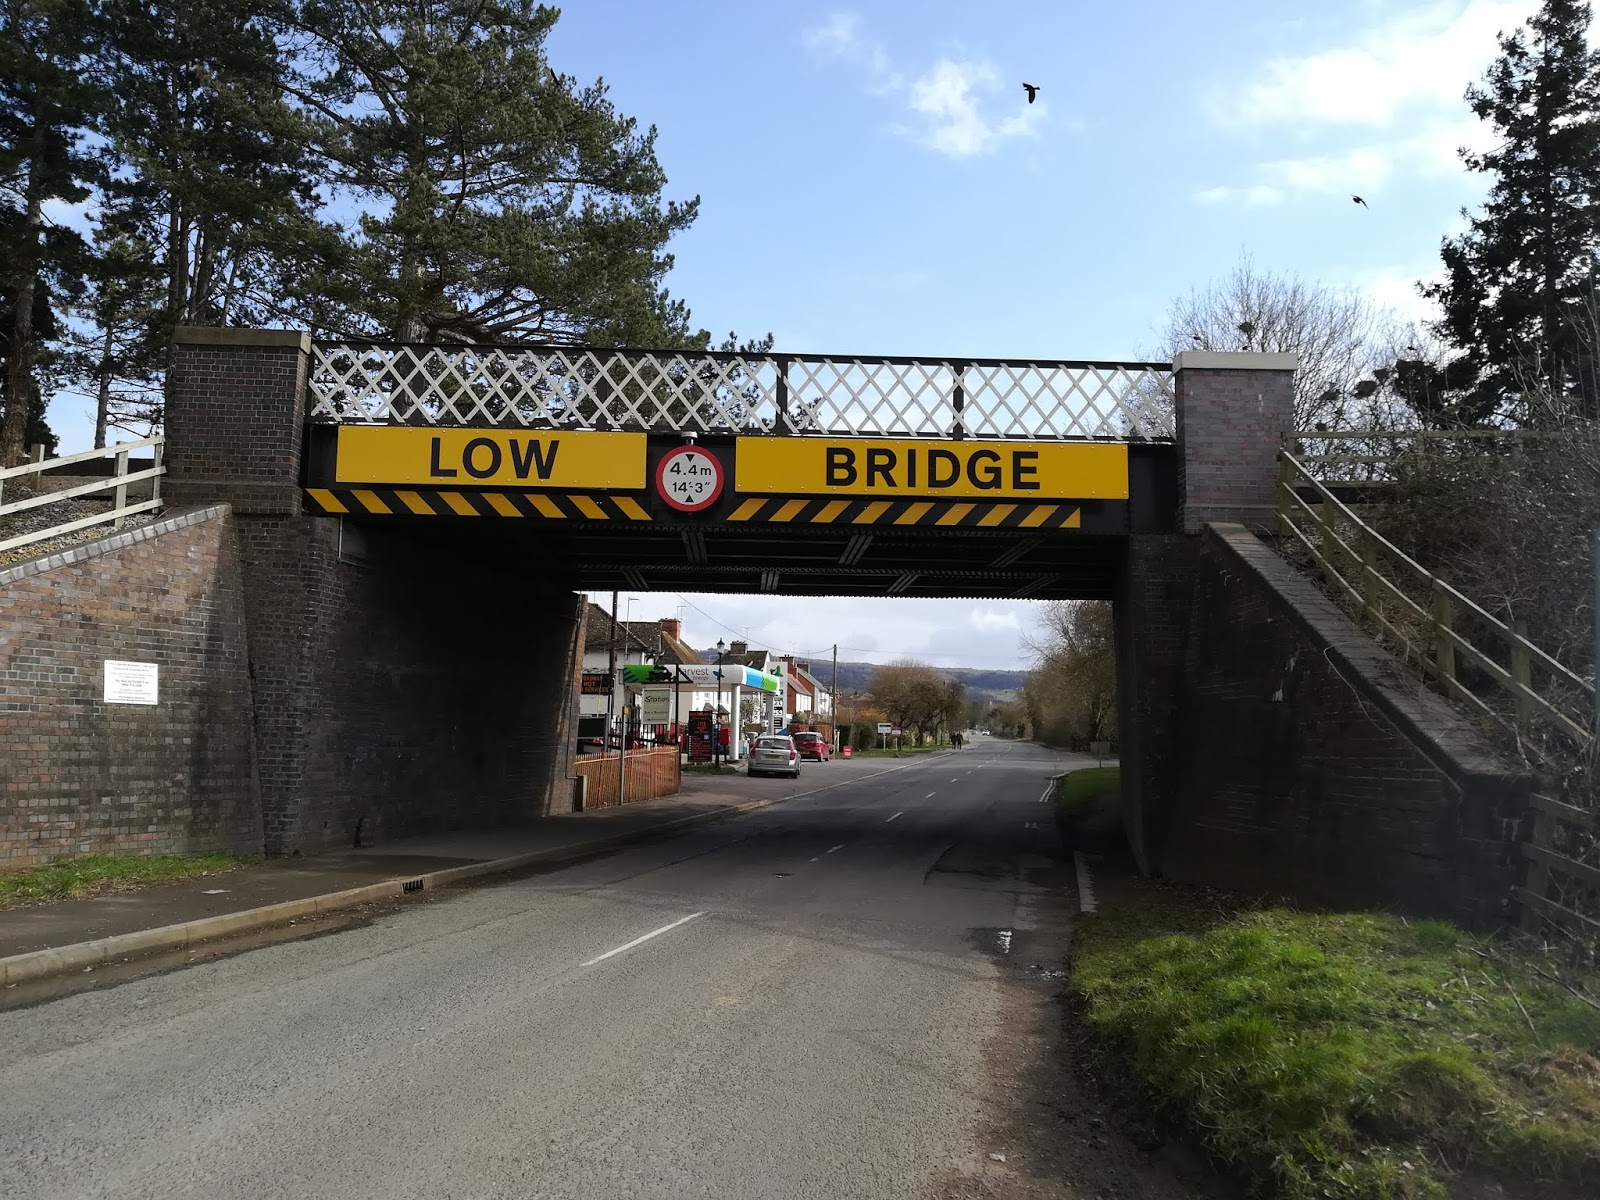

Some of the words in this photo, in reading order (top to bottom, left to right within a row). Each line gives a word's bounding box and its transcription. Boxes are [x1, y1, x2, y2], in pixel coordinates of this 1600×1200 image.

[430, 437, 560, 481] LOW
[826, 447, 1040, 491] BRIDGE
[680, 667, 709, 676] arvest
[644, 695, 669, 703] Station
